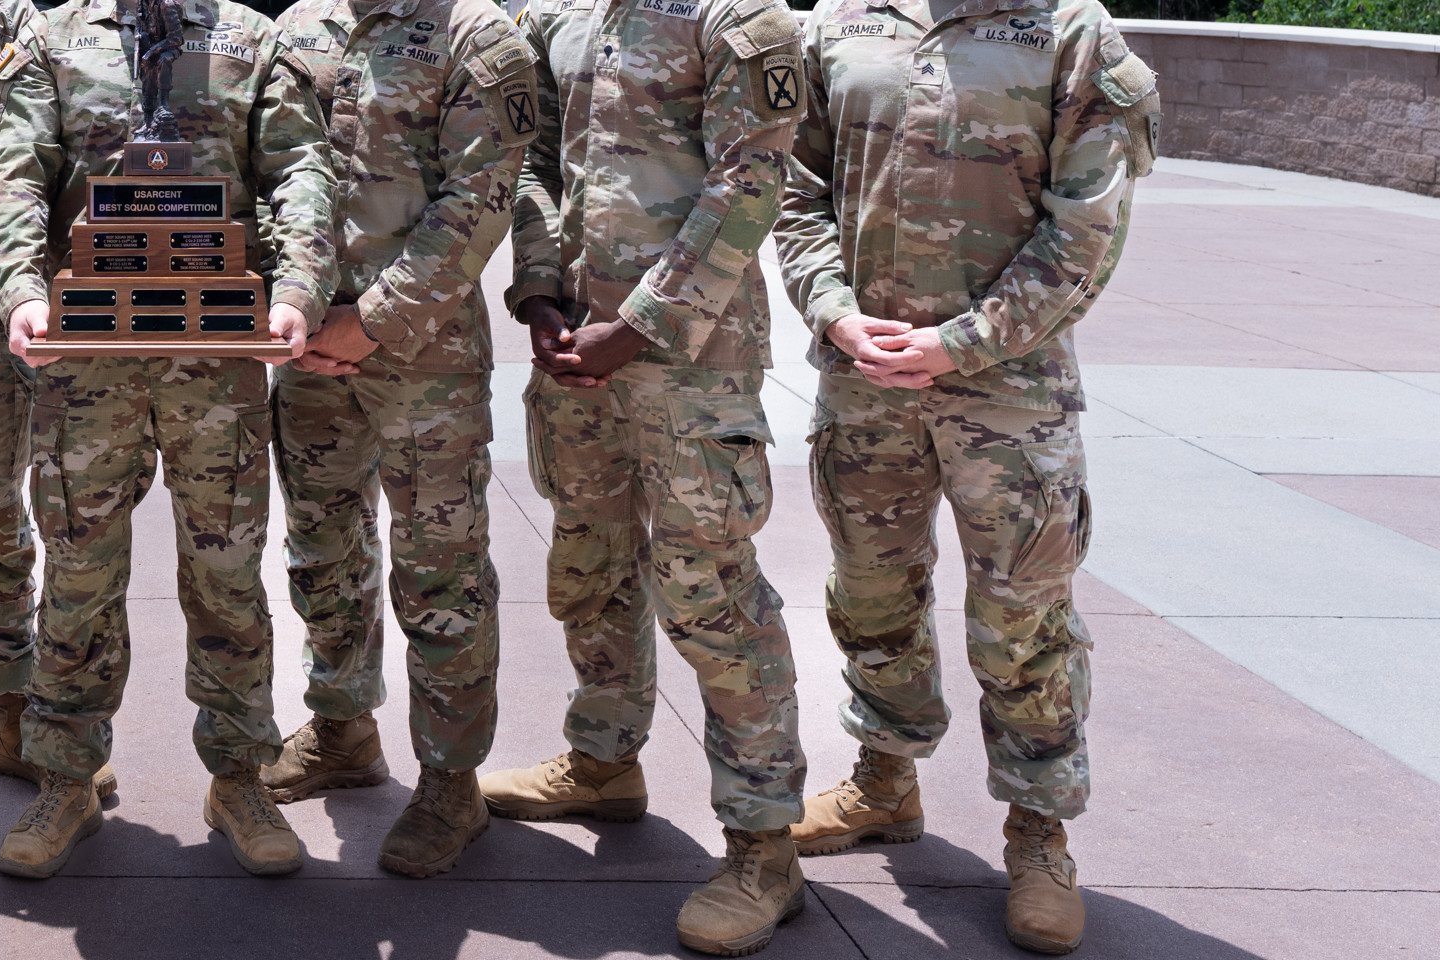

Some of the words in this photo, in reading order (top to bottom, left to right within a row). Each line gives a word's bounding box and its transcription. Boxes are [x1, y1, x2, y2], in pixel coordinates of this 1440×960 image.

[667, 2, 696, 17] ARMY
[839, 23, 885, 36] KRAMER
[67, 37, 101, 49] LANE
[293, 37, 317, 48] RNER
[985, 29, 1007, 41] U.S.
[1011, 31, 1048, 50] ARMY
[186, 41, 209, 52] U.S.
[211, 42, 248, 58] ARMY
[386, 44, 404, 56] U.S.
[408, 47, 440, 65] ARMY
[134, 190, 182, 199] USARCENT
[99, 203, 122, 212] BEST
[124, 203, 156, 212] SQUAD
[157, 203, 218, 212] COMPETITION
